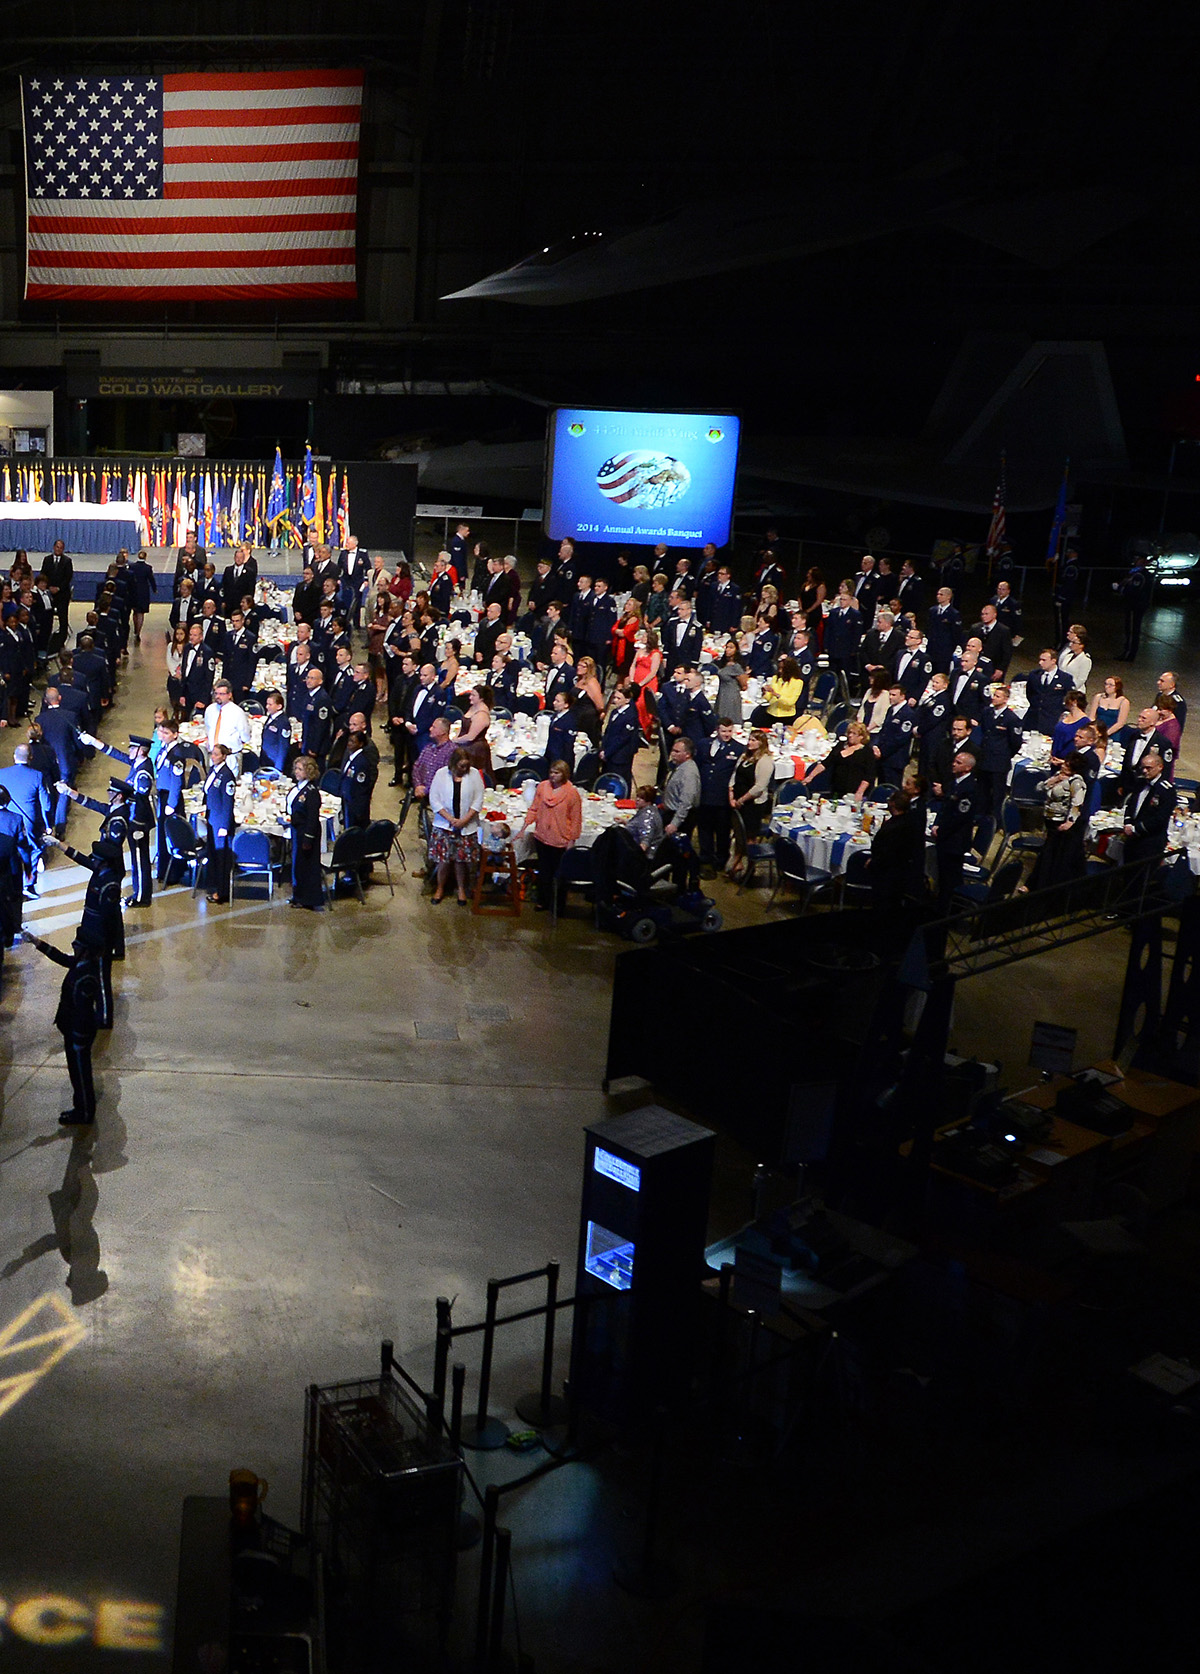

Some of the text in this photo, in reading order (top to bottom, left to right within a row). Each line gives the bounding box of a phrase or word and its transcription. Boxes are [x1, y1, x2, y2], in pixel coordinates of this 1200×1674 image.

[98, 384, 284, 396] COLD WAR GALLERY
[576, 523, 703, 540] 2014 Annual Awards Banquet
